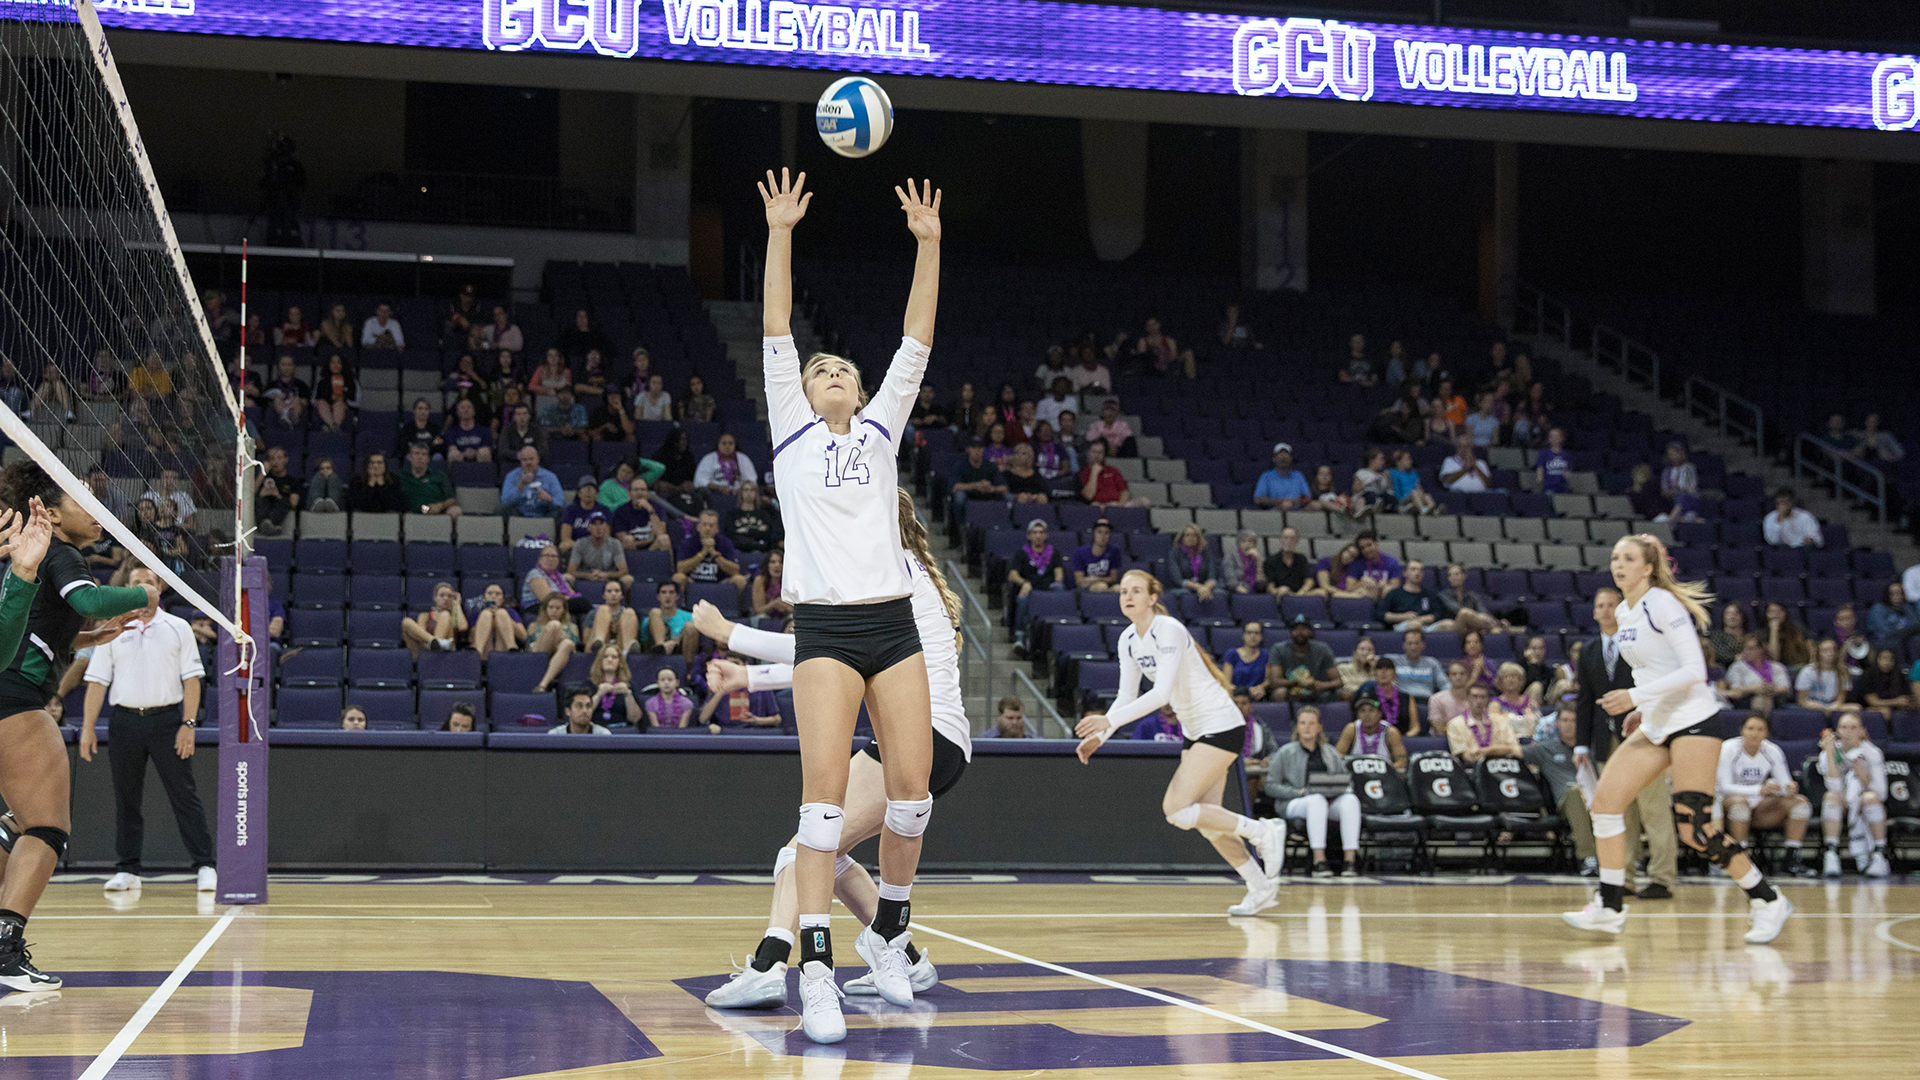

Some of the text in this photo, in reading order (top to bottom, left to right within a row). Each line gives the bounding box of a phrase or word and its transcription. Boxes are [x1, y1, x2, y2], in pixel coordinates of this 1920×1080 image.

[482, 0, 930, 57] GCU VOLLEYBALL
[1232, 18, 1637, 101] GCU VOLLEYBALL
[1872, 56, 1920, 131] G
[818, 103, 842, 114] olten
[824, 446, 870, 487] 14
[1352, 758, 1387, 774] GCU
[1419, 758, 1454, 773] GCU
[1486, 758, 1520, 774] GCU
[1364, 780, 1384, 799] G
[1432, 777, 1452, 797] G
[1500, 778, 1520, 798] G
[235, 761, 249, 846] sports imports
